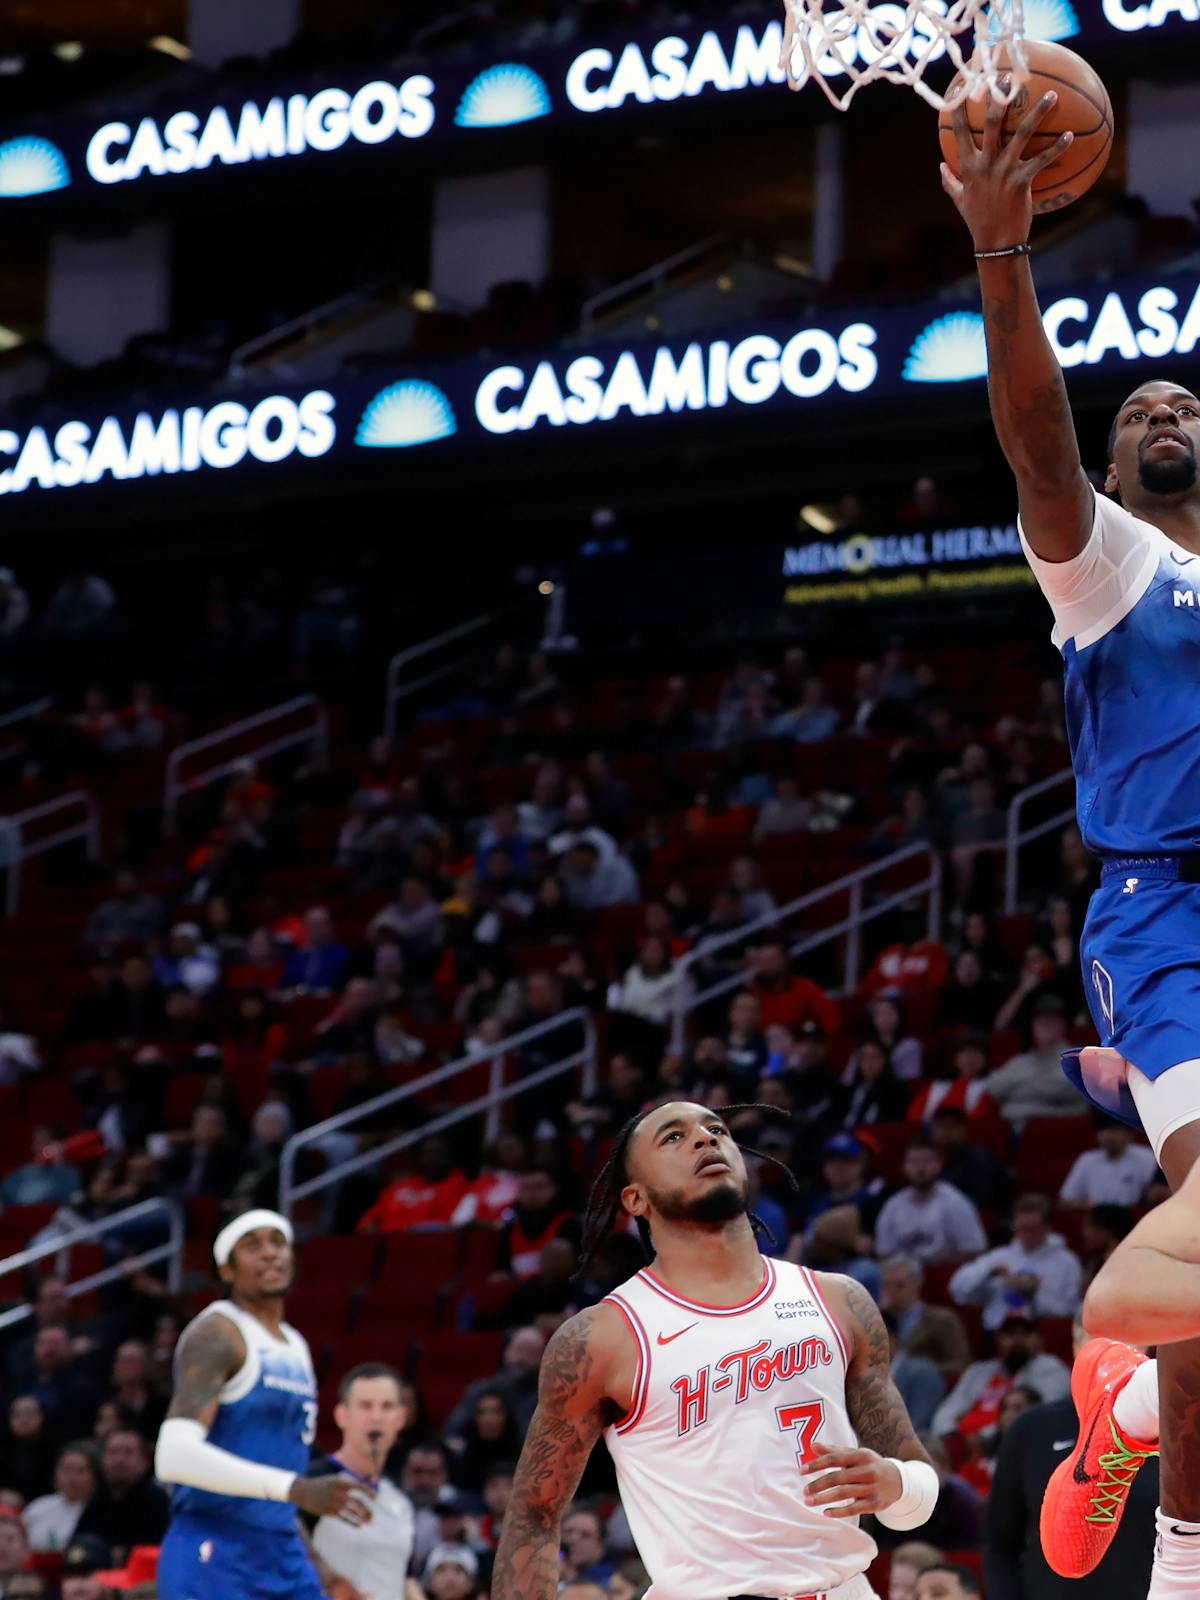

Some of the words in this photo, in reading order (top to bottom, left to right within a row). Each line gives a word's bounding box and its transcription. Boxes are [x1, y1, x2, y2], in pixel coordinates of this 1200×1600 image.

[87, 75, 435, 183] CASAMIGOS
[475, 323, 878, 434] CASAMIGOS
[783, 534, 928, 577] MEMORIAL
[774, 1299, 815, 1310] credit
[775, 1310, 820, 1320] karma
[671, 1334, 833, 1437] H-Town
[301, 1400, 318, 1446] 3
[775, 1399, 825, 1472] 7
